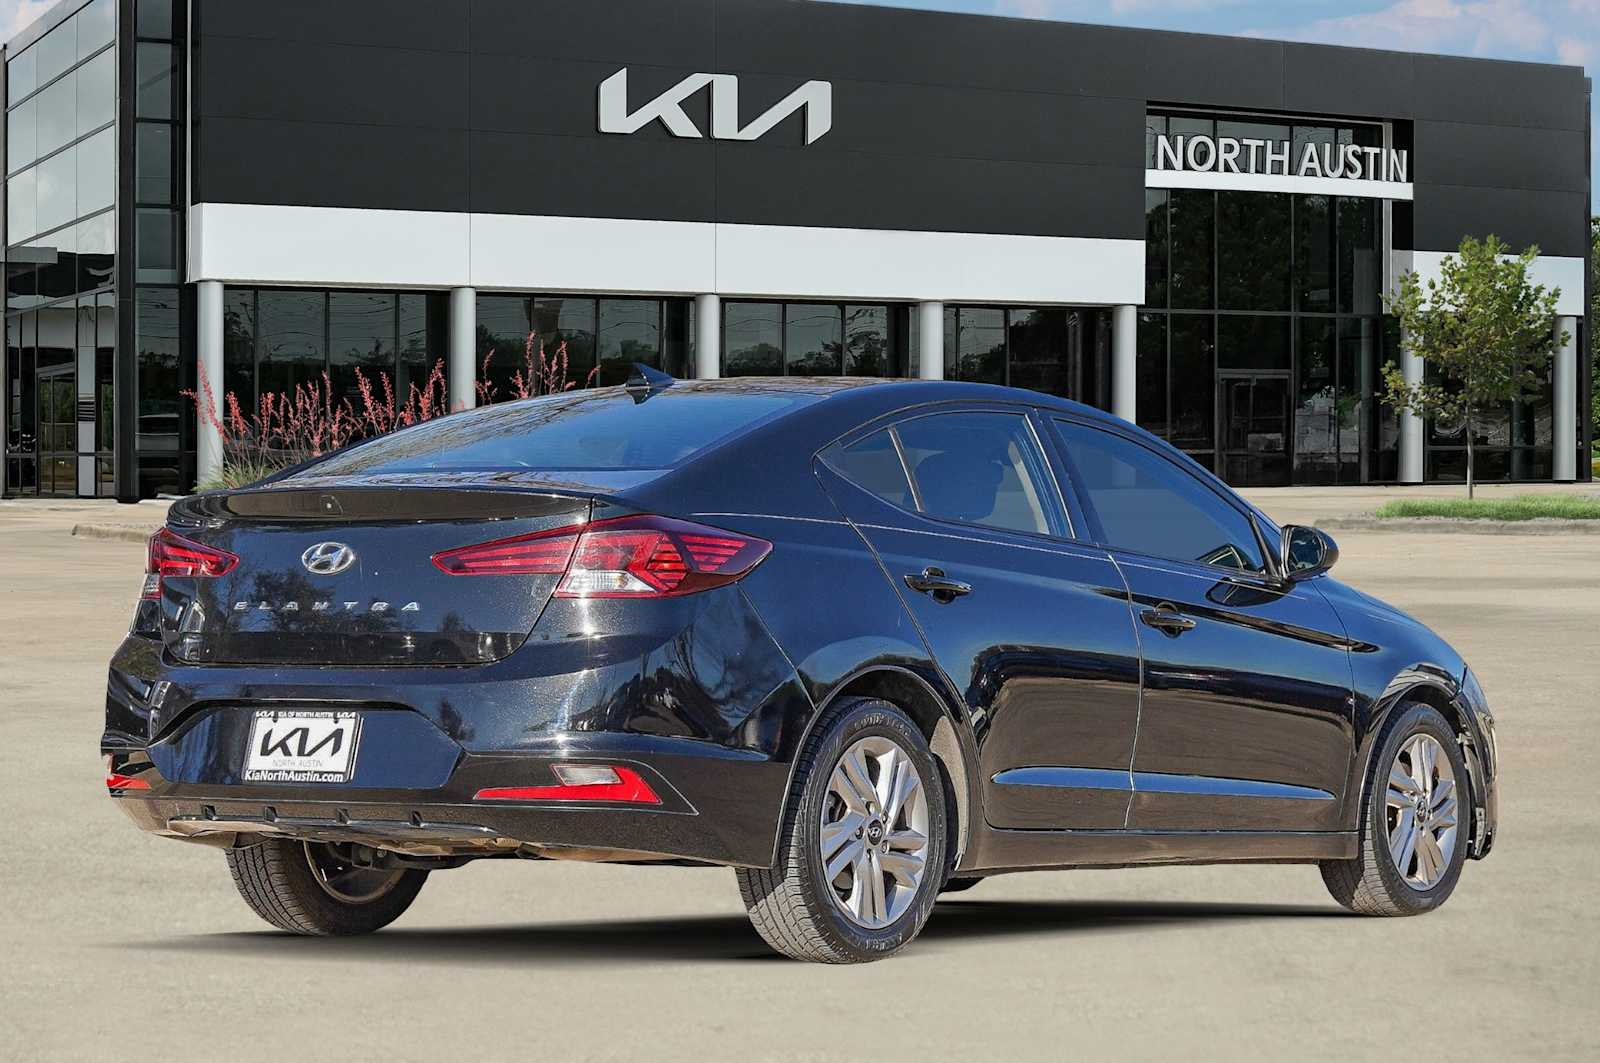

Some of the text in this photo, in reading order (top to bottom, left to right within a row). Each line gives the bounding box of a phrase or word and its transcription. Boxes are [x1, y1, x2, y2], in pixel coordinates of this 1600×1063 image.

[598, 67, 832, 145] KIA
[1157, 134, 1408, 183] NORTH AUSTIN
[233, 601, 419, 611] ELANTRA
[260, 728, 344, 757] KIA
[245, 770, 344, 782] KiaNorthAustin.com
